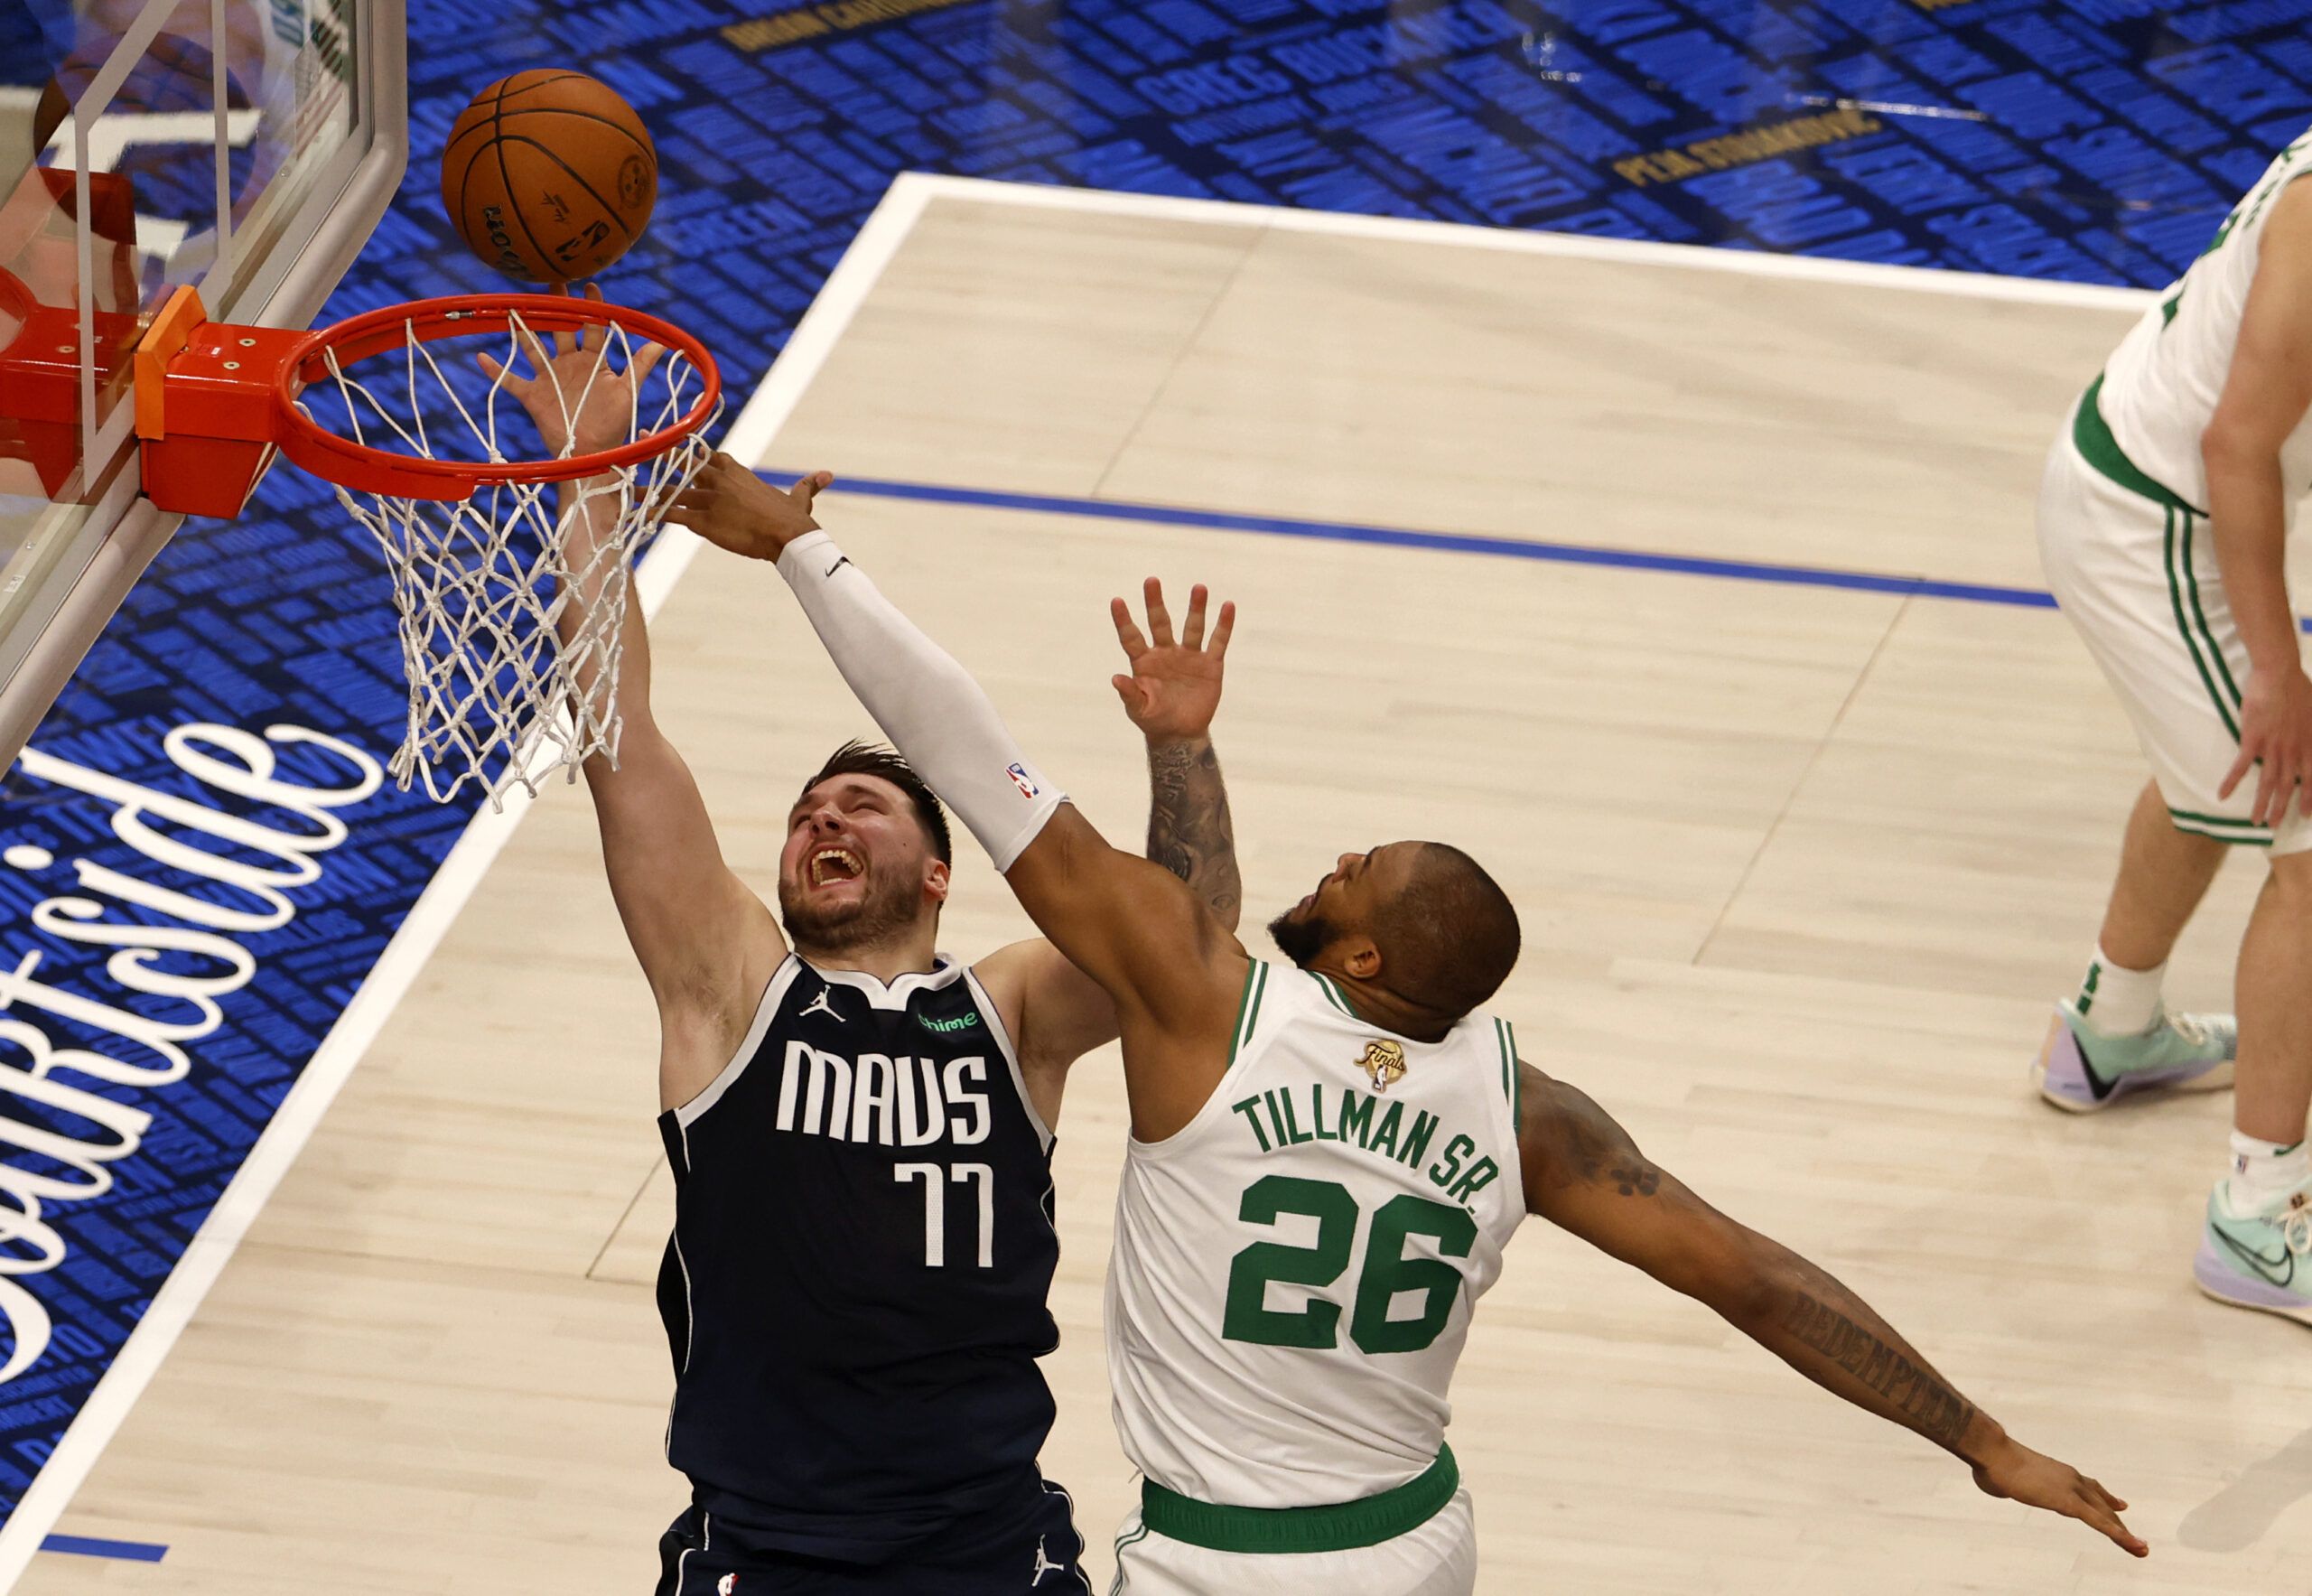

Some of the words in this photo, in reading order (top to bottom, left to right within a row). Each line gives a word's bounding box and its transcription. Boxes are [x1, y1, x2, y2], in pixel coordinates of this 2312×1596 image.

[918, 1010, 978, 1033] chime
[1354, 1041, 1406, 1072] Finals
[776, 1040, 992, 1147] MAVS
[1232, 1083, 1440, 1169] TILLMAN
[1429, 1134, 1499, 1215] SR.
[894, 1162, 993, 1268] 77
[1222, 1174, 1478, 1355] 26
[1778, 1291, 1977, 1448] REDEMPTION
